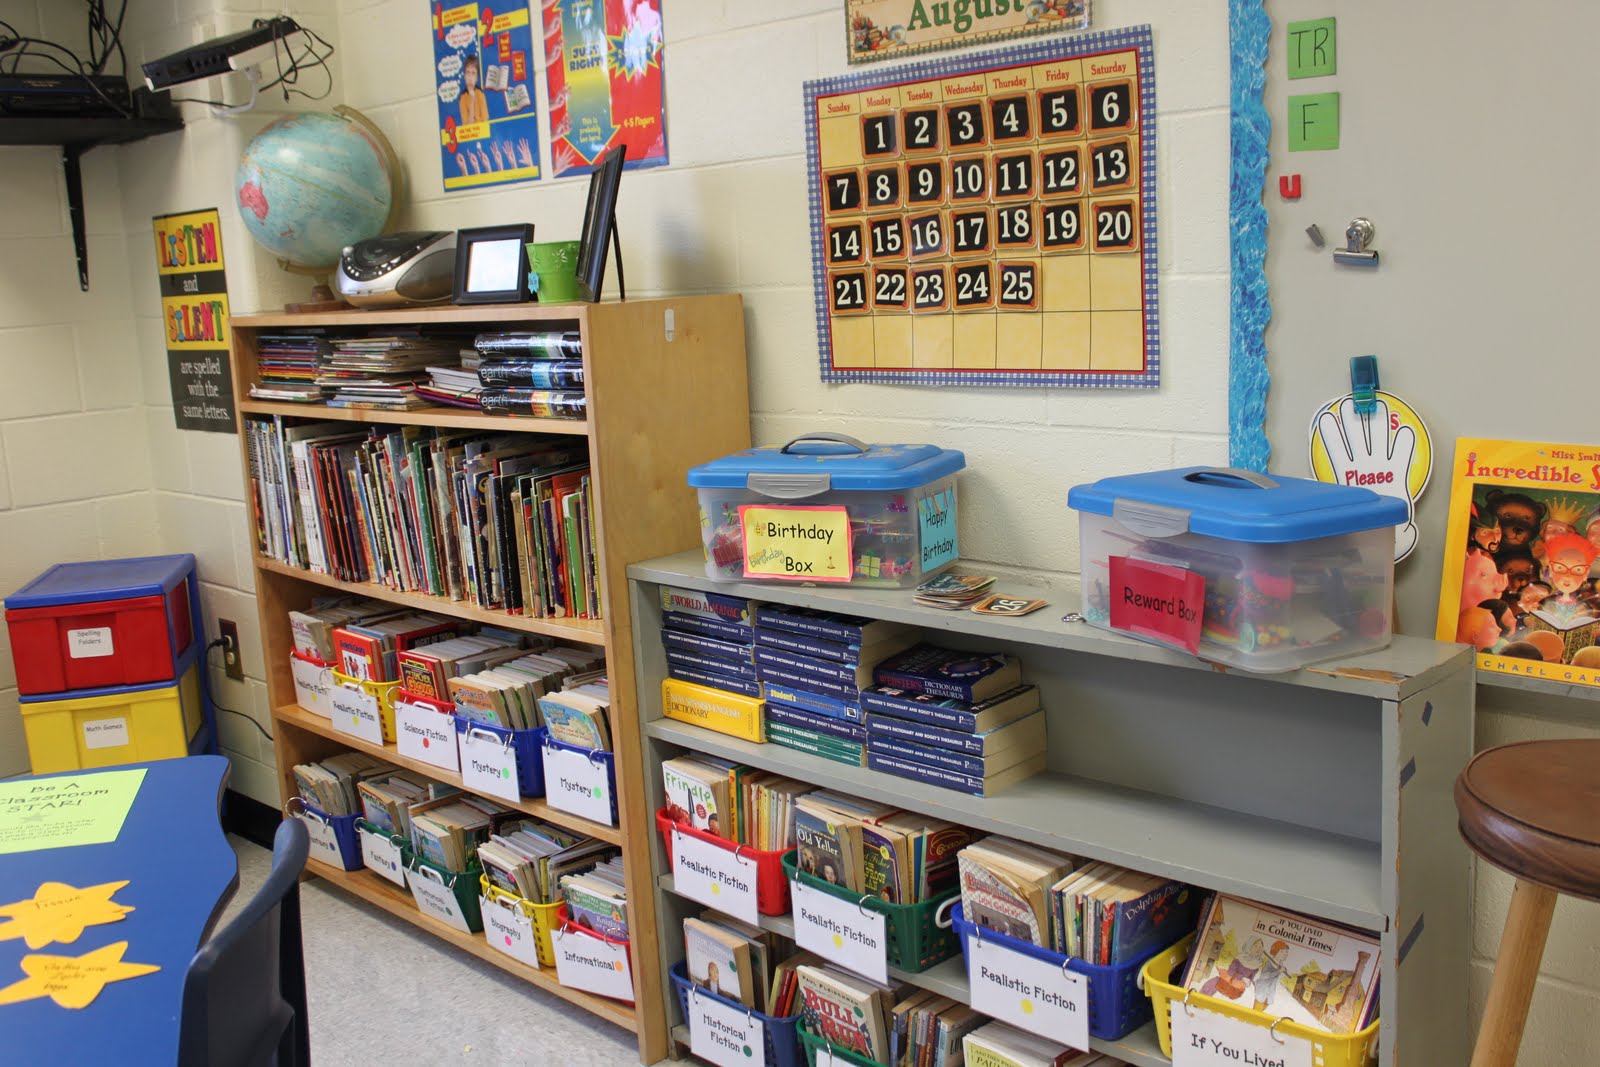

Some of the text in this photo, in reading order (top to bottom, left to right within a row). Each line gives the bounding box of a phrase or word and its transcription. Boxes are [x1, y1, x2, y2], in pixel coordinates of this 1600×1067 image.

[907, 0, 1025, 33] August
[1289, 27, 1329, 68] TR
[827, 61, 1128, 114] Sunday Monday Tuesday Wednesday Thursday Friday Saturday
[876, 92, 1120, 148] 1 2 3 4 5 6
[1303, 103, 1319, 141] F
[836, 149, 1127, 204] 7 8 9 10 11 12 13
[832, 208, 1131, 257] 14 15 16 17 18 19 20
[183, 276, 198, 292] and
[836, 271, 1033, 305] 21 22 23 24 25
[181, 358, 221, 378] are spelled
[481, 365, 508, 378] earth
[188, 381, 219, 397] with the
[481, 394, 508, 407] earth
[183, 406, 203, 418] same
[1551, 450, 1600, 462] Miss Smit
[1345, 470, 1394, 487] Please
[1464, 452, 1584, 484] Incredible
[926, 509, 948, 529] Happy
[768, 522, 834, 545] Birthday
[923, 537, 954, 563] Birthday
[785, 556, 813, 573] Box
[673, 594, 702, 611] WORLD
[702, 603, 740, 619] ALMANAC
[1123, 586, 1198, 625] Reward Box
[1483, 660, 1546, 676] CHAEL
[924, 681, 963, 692] DICTIONARY
[925, 688, 964, 700] THESAURUS
[671, 702, 709, 719] DICTIONARY
[934, 712, 956, 721] THESAURUS
[403, 722, 448, 742] Science Fiction
[940, 736, 963, 746] THESAURUS
[472, 760, 501, 779] Mystery
[943, 774, 965, 783] THESAURUS
[560, 778, 592, 797] Mystery
[665, 771, 711, 803] Frindle
[797, 828, 813, 845] Old
[814, 835, 839, 856] Yeller
[680, 855, 749, 893] Realistic Fiction
[490, 917, 521, 940] Biography
[801, 908, 877, 949] Realistic Fiction
[1256, 921, 1334, 952] in Colonial Times
[1287, 921, 1303, 931] YOU
[1303, 926, 1323, 938] LIVED
[564, 951, 615, 971] Informational
[981, 966, 1076, 1012] Realistic Fiction
[803, 986, 859, 1028] BULL
[703, 1014, 747, 1041] Historical
[819, 1013, 871, 1058] RUN
[710, 1031, 740, 1053] Fiction
[1191, 1033, 1285, 1067] If You Lived
